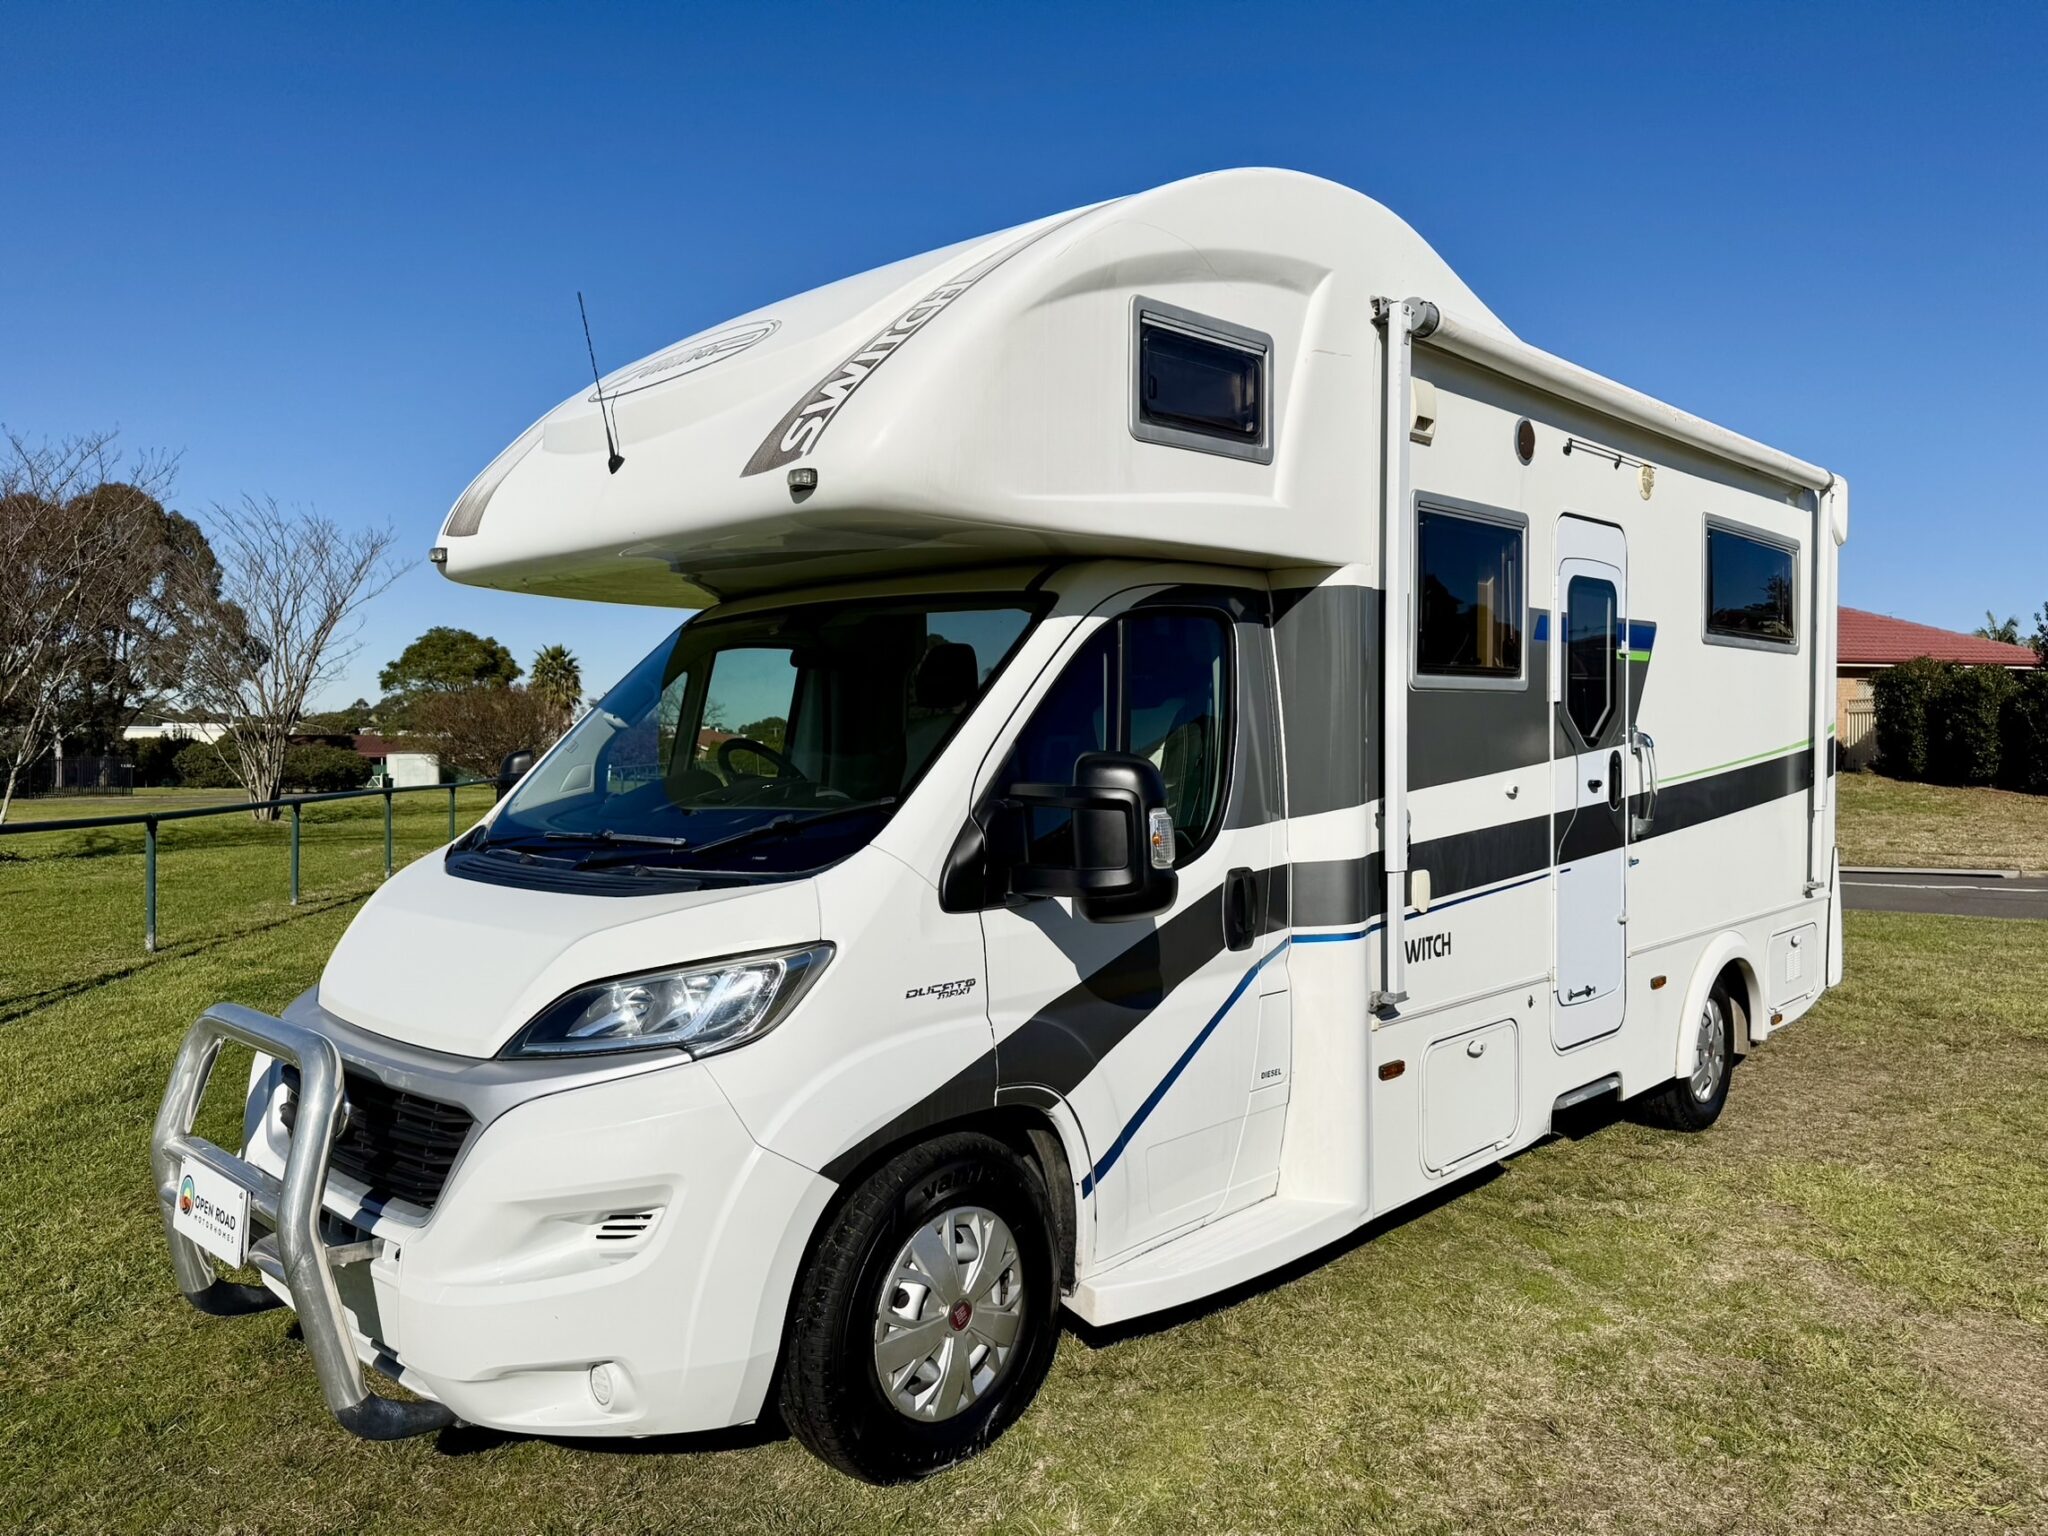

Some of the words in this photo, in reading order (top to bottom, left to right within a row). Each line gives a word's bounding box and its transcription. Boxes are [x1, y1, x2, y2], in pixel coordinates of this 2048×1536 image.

[779, 281, 971, 455] SWITCH
[1404, 931, 1452, 965] WITCH
[905, 978, 976, 999] DUCATO
[194, 1215, 234, 1244] MOTORHOMES
[195, 1195, 214, 1217] OPEN
[215, 1208, 236, 1231] ROAD
